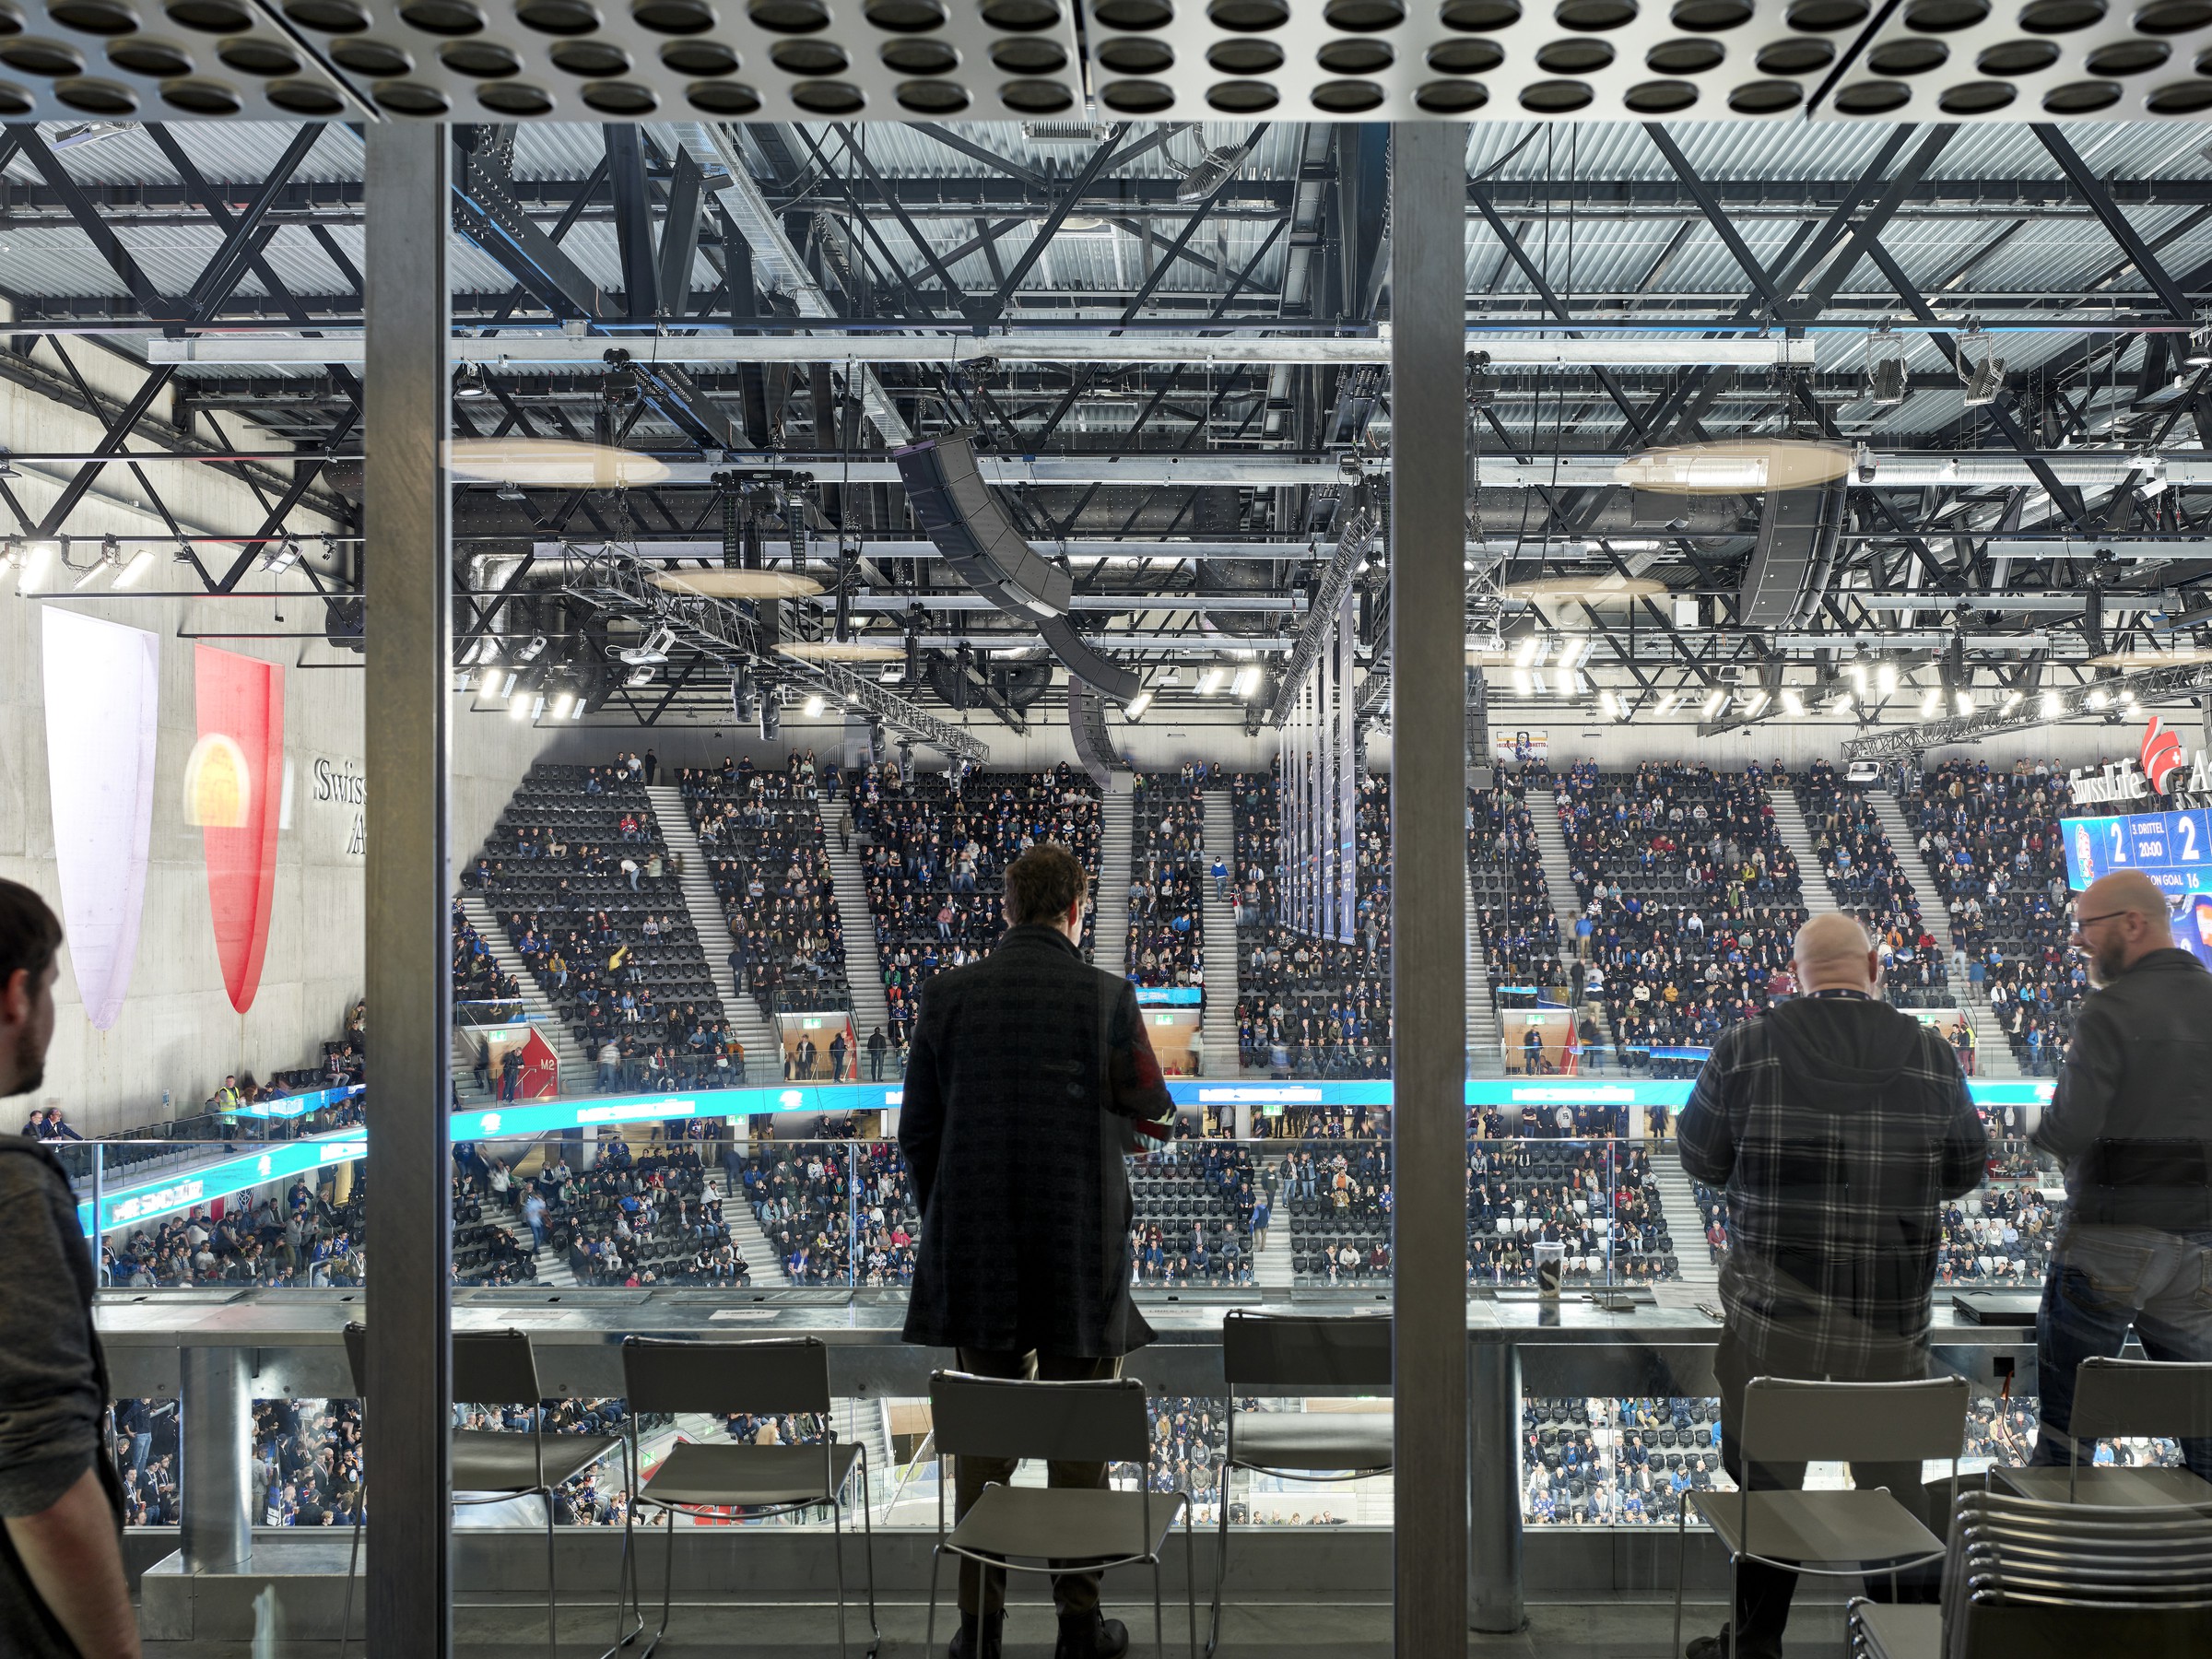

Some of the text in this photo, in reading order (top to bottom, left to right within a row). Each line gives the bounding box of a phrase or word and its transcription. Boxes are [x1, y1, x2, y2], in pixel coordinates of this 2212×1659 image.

[2132, 822, 2165, 835] 3. DRITTEL
[2111, 822, 2126, 863] 2
[2178, 816, 2200, 861] 2
[2139, 841, 2162, 857] 20:00
[2150, 873, 2200, 888] ON GOAL 16
[540, 1058, 555, 1071] M2
